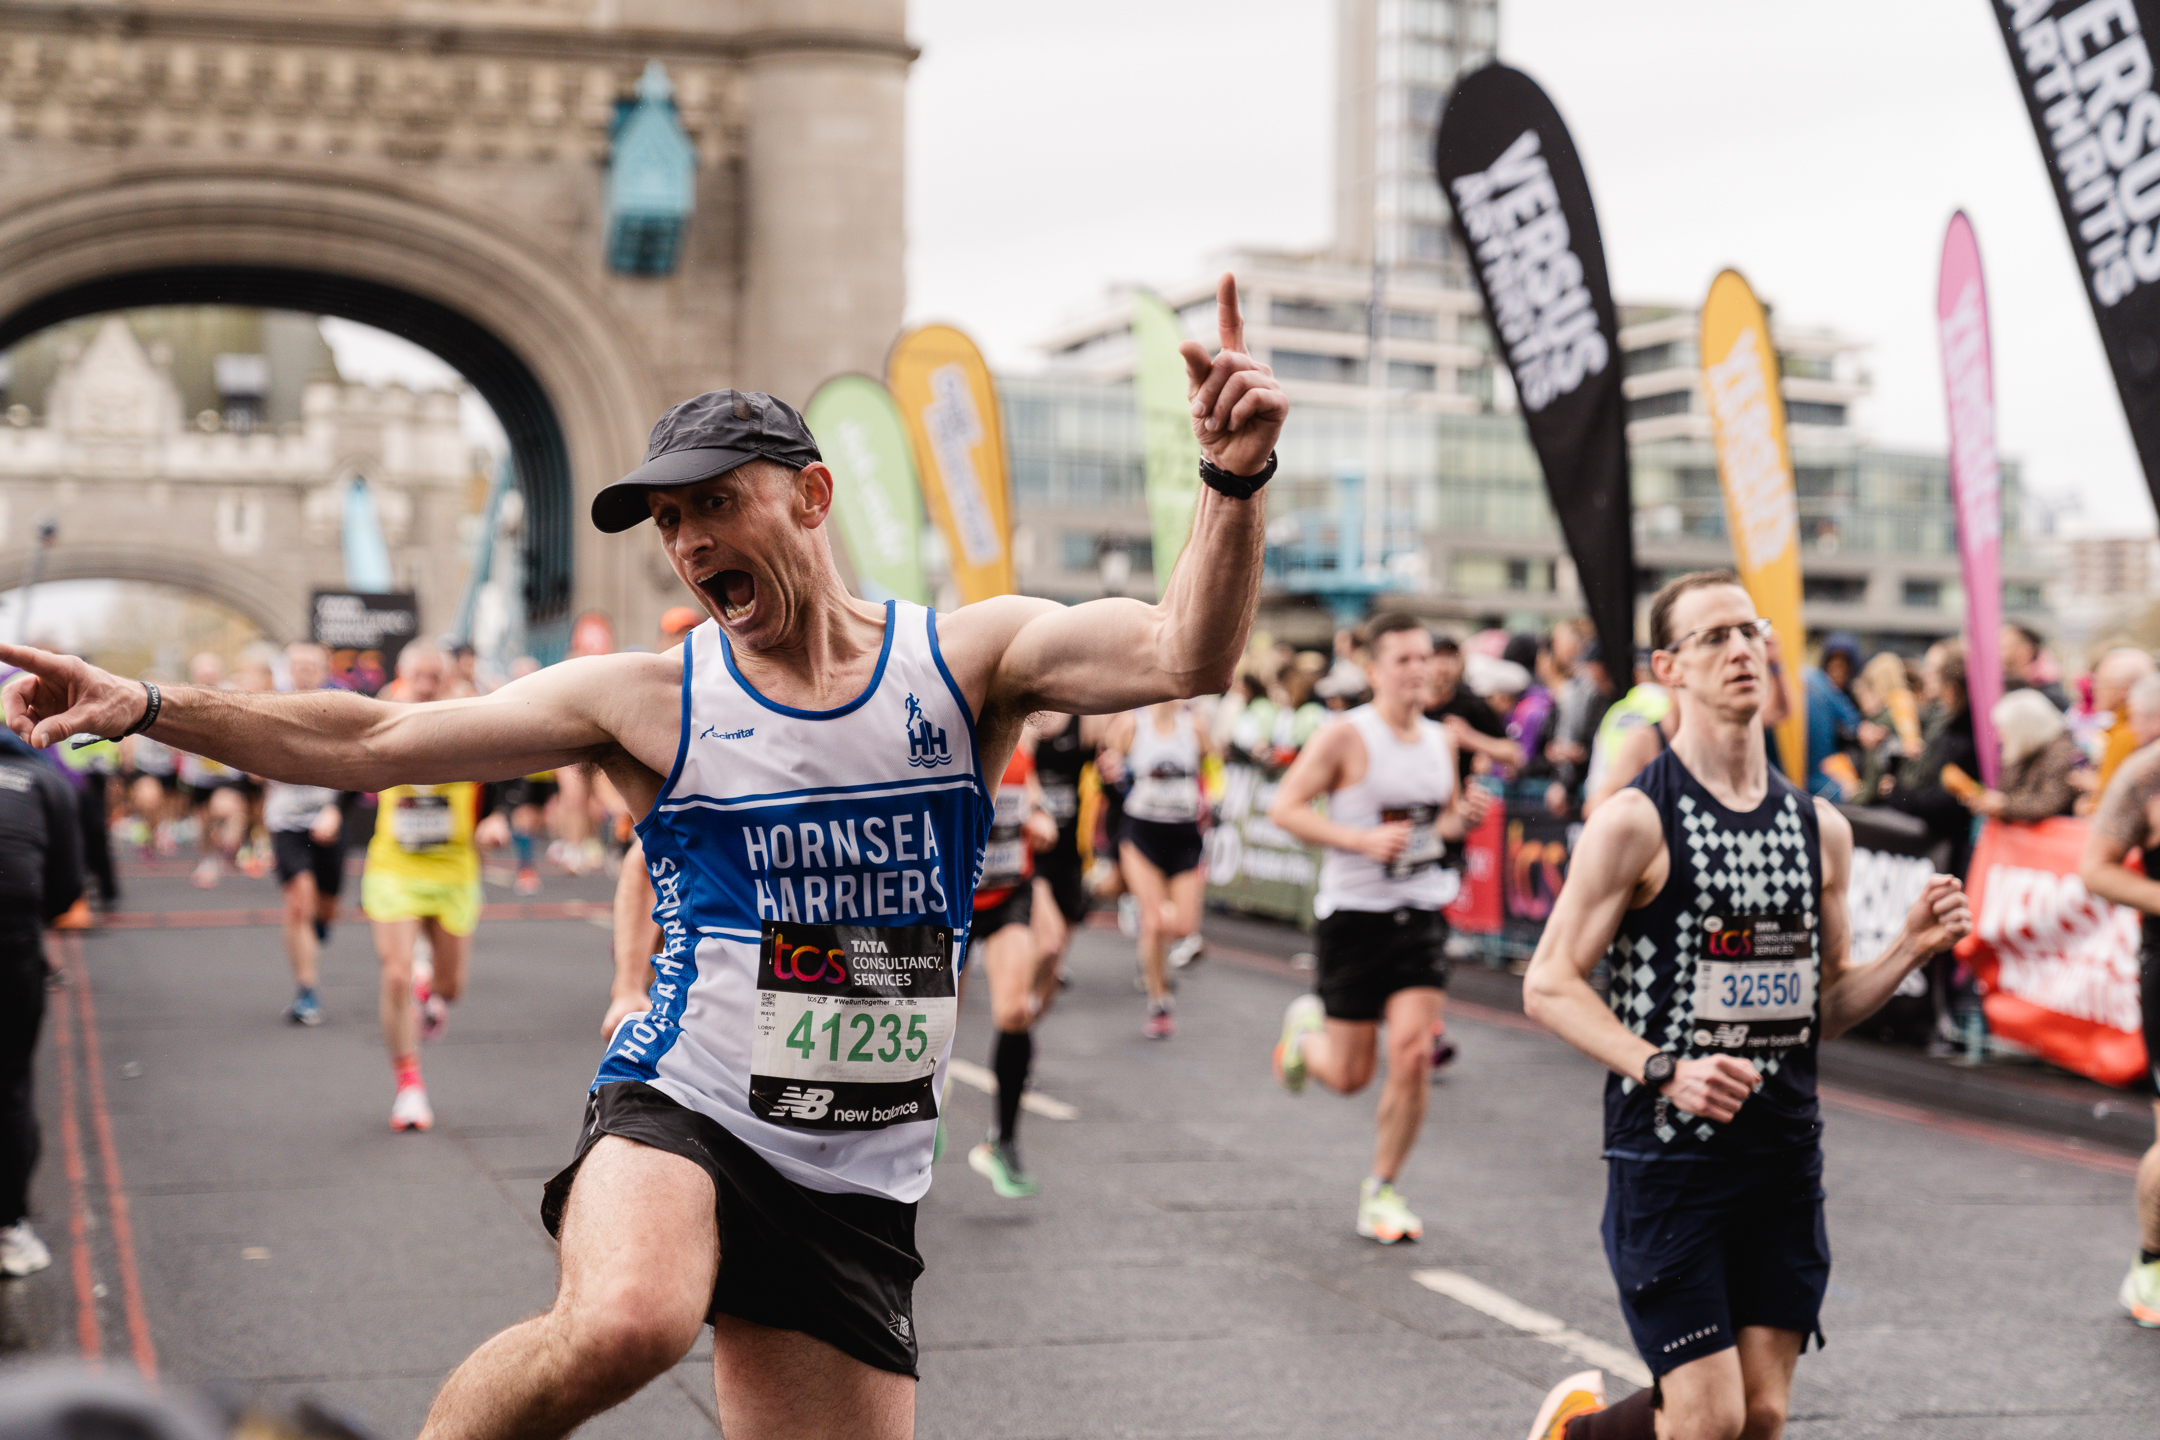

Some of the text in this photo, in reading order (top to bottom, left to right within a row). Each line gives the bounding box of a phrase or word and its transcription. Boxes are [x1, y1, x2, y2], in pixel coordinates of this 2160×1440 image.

[1484, 128, 1609, 395] VERSUS
[742, 811, 939, 871] HORNSEA
[754, 865, 948, 923] HARRIERS
[774, 933, 846, 984] tcs
[851, 940, 889, 954] TATA
[852, 956, 941, 970] CONSULTANCY
[854, 973, 912, 987] SERVICES
[1721, 972, 1801, 1008] 32550
[834, 998, 890, 1007] #WeRunTogether
[786, 1010, 928, 1062] 41235
[769, 1086, 918, 1122] NB new balance
